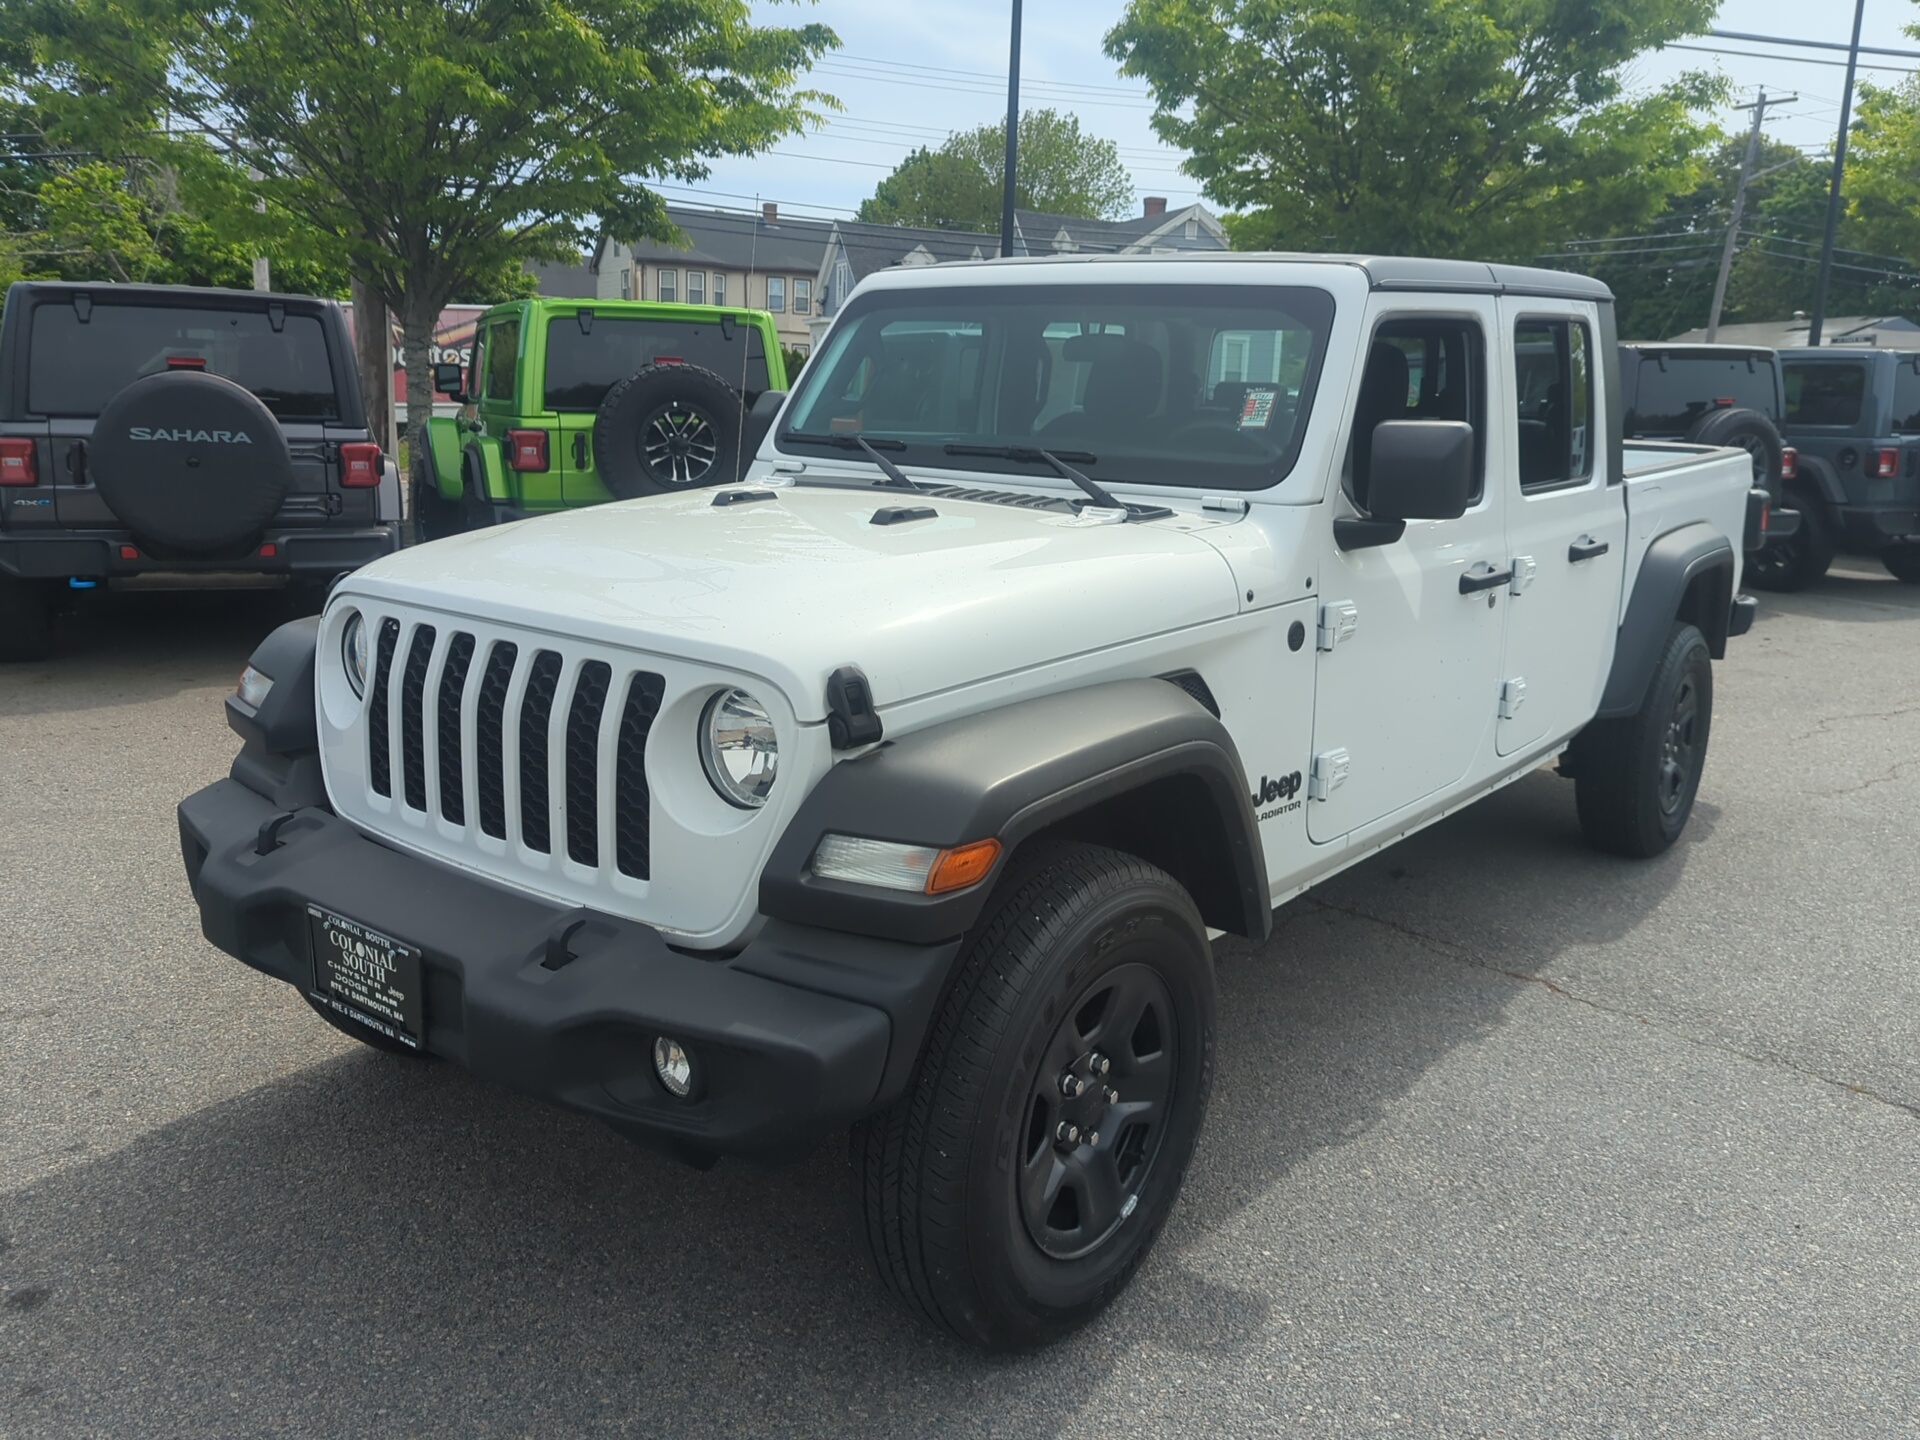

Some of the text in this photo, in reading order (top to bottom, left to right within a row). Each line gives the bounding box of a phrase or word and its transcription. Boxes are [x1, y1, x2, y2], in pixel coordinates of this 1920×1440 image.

[129, 427, 252, 444] SAHARA
[1251, 770, 1302, 808] Jeep
[1255, 801, 1301, 823] LADIATOR
[327, 914, 391, 949] COLONIAL SOUTH
[330, 930, 397, 973] COLONIAL
[342, 951, 386, 984] SOUTH
[327, 960, 405, 1001] CHRYSLER Jeep
[335, 972, 398, 1008] DODGE RAM
[330, 980, 344, 994] RTE.
[351, 990, 393, 1018] DARTMOUTH,
[393, 1010, 404, 1022] MA
[349, 1009, 385, 1035] DARTMOUTH,
[385, 1026, 395, 1038] MA
